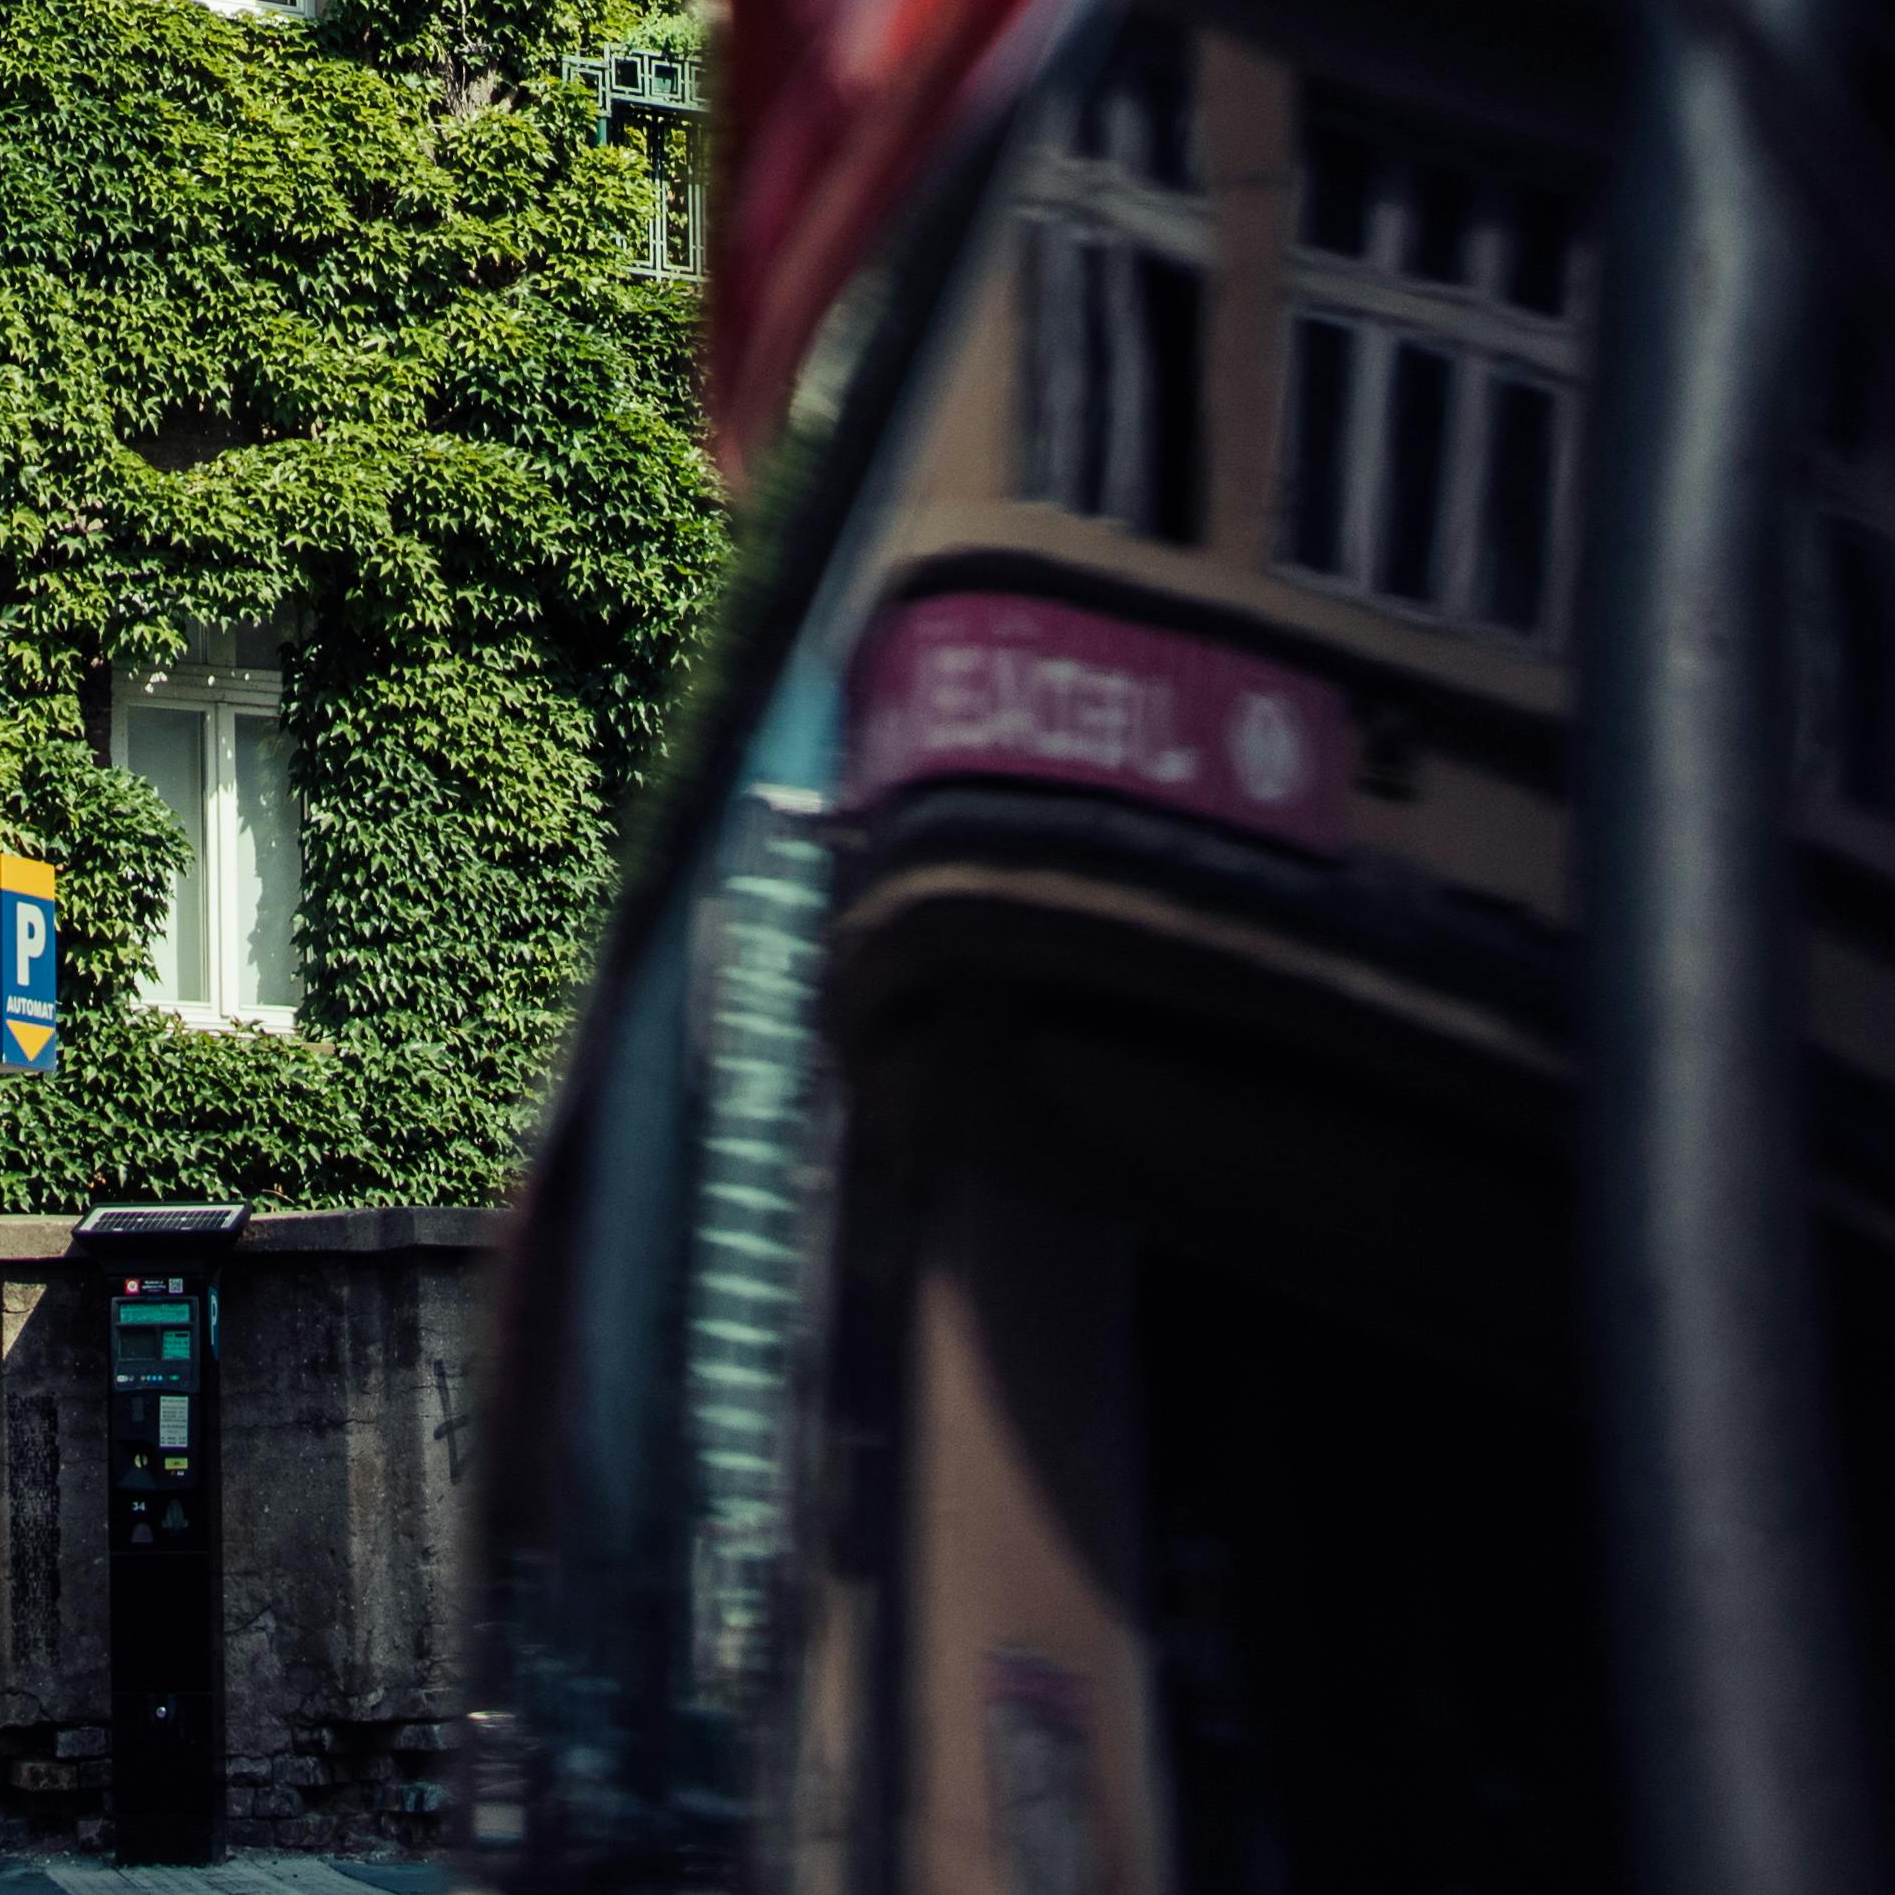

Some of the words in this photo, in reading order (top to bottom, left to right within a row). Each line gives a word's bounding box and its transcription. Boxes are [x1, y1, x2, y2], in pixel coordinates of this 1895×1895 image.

[16, 901, 46, 987] P
[6, 995, 54, 1021] AUTOMAT
[132, 1501, 146, 1512] 34
